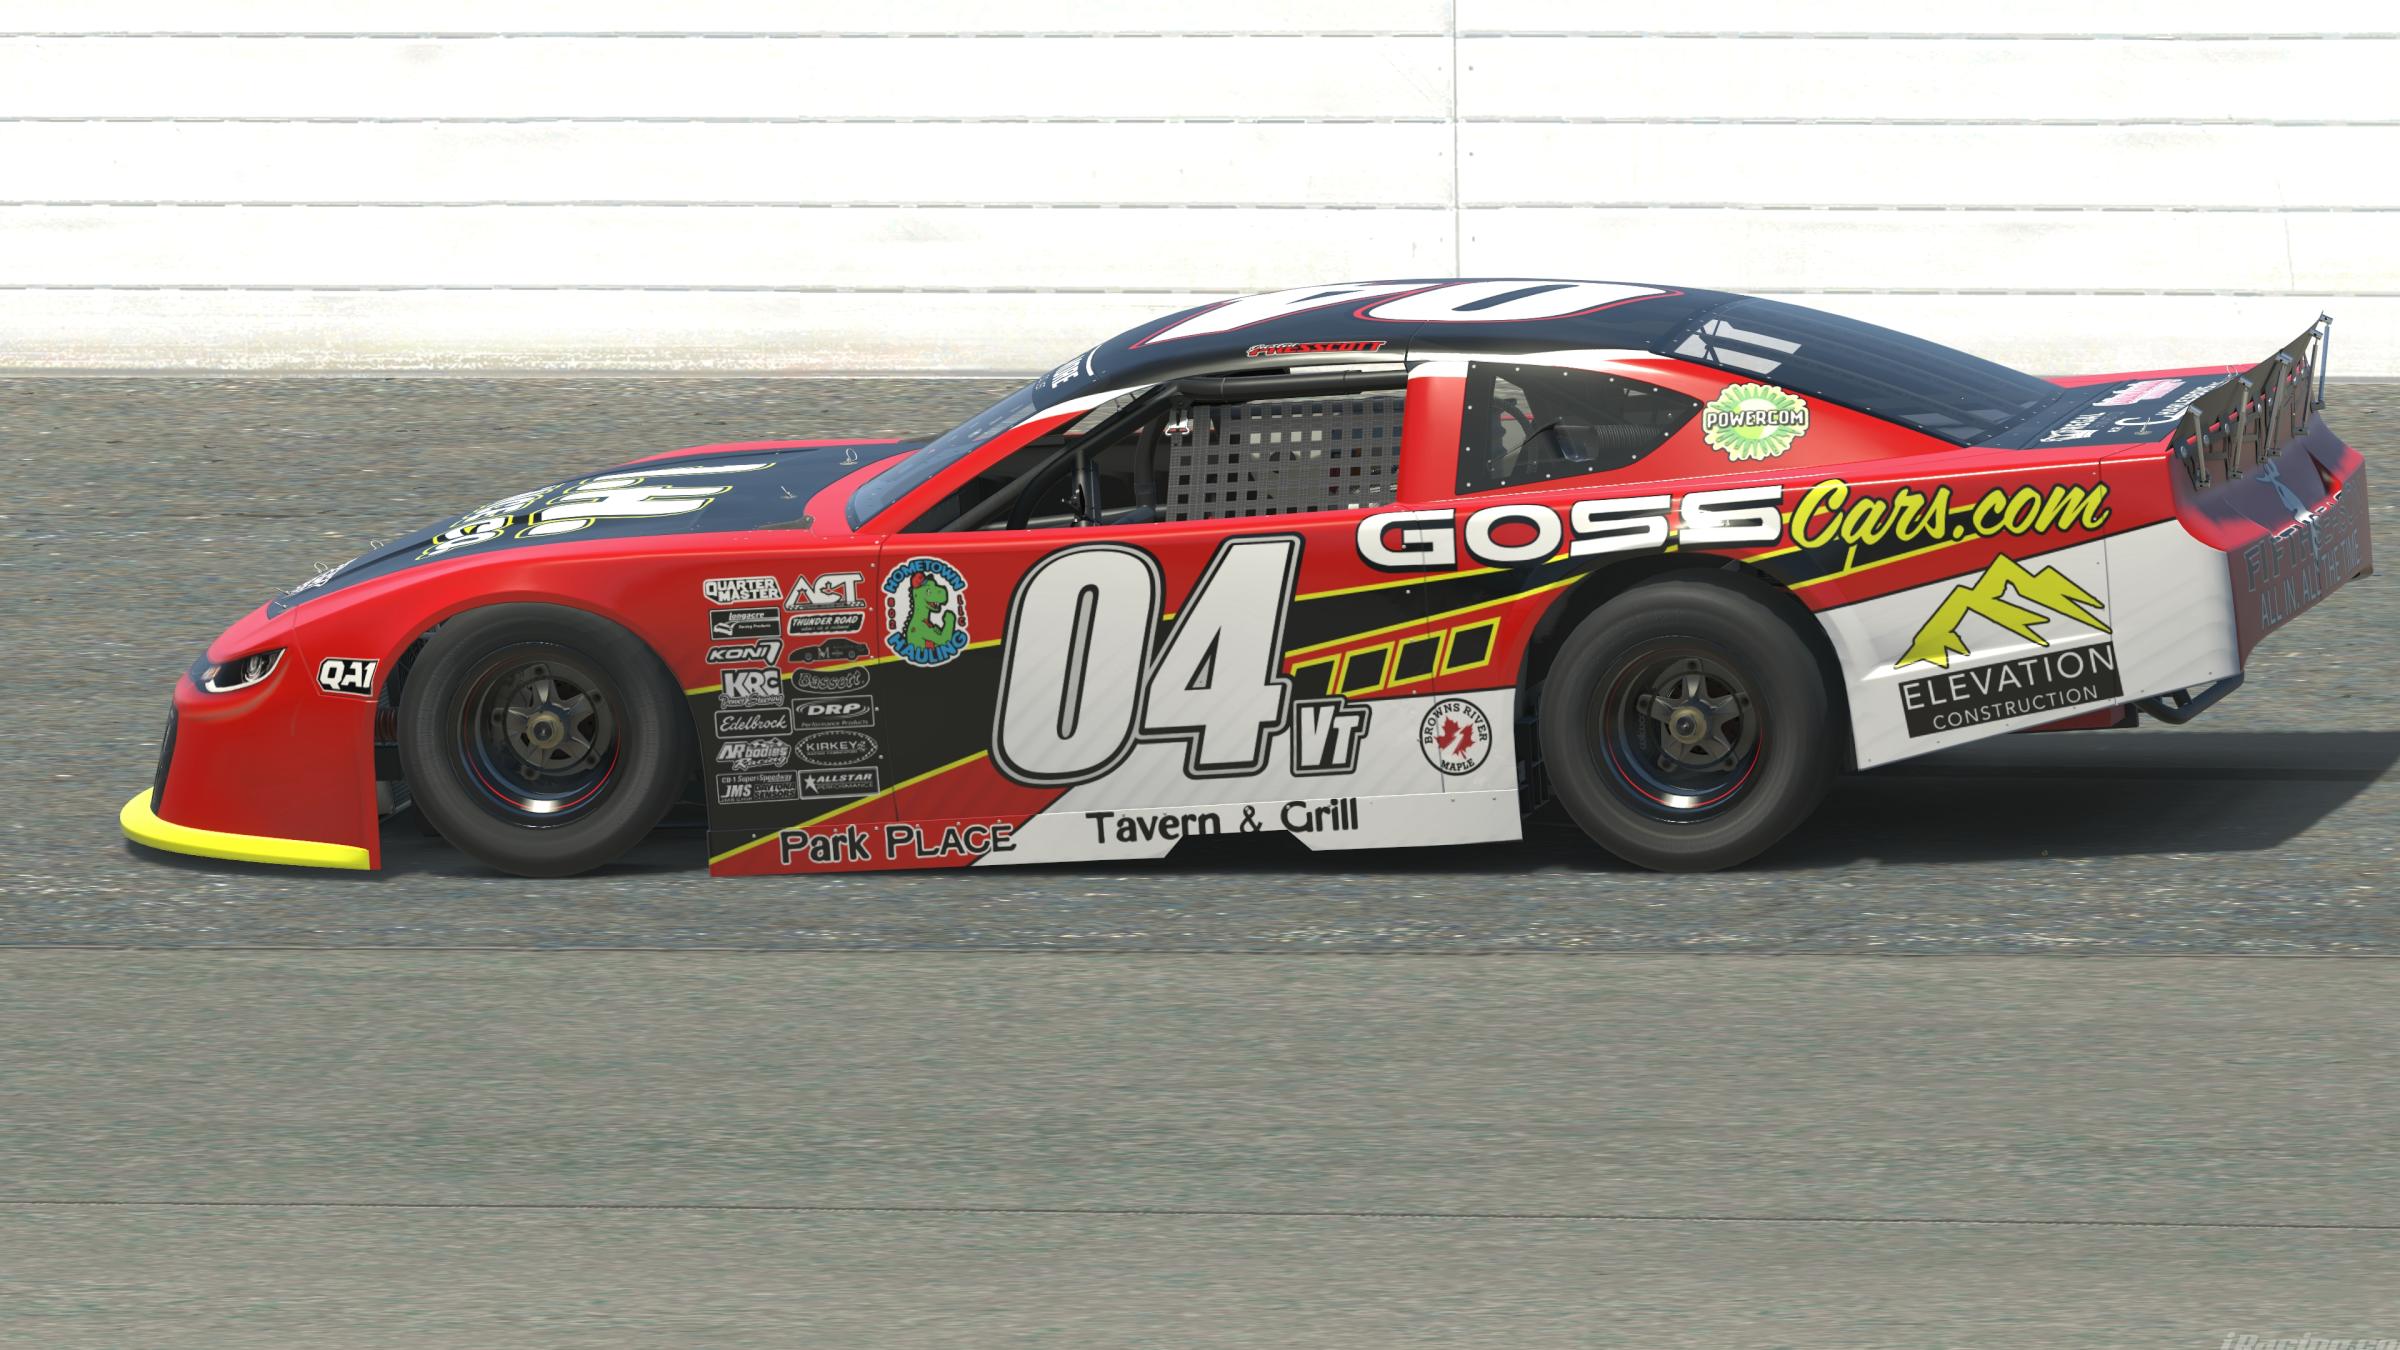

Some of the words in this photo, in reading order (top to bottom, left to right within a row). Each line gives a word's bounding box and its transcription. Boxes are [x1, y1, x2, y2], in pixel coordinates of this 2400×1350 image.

[1706, 410, 1805, 429] POWERCOM
[1356, 484, 1784, 573] GOSS
[1790, 478, 2112, 549] Cars.com
[705, 578, 774, 596] QUARTER
[883, 559, 966, 594] HOMETOWN
[718, 588, 779, 602] MASTER
[785, 573, 864, 609] ACT
[793, 616, 833, 627] THUNDER
[834, 615, 859, 625] ROAD
[887, 630, 968, 664] HAULING
[990, 534, 1303, 785] 04
[320, 660, 376, 690] QA1
[723, 670, 780, 697] KRC
[1902, 645, 2116, 711] ELEVATION
[807, 703, 861, 716] DRP
[1933, 685, 2098, 730] CONSTRUCTION
[720, 713, 788, 732] Edelbrock
[1294, 698, 1369, 774] VT
[1424, 703, 1460, 744] BROWNS
[1463, 706, 1488, 742] RIVER
[806, 740, 858, 751] KIRKEY
[816, 773, 873, 782] ALLSTAR
[1440, 758, 1475, 771] MAPLE
[720, 784, 752, 798] JMS
[779, 824, 871, 864] Park
[884, 823, 1017, 859] PLACE
[1085, 811, 1221, 844] Tavern
[1239, 805, 1263, 833] &
[1280, 797, 1359, 833] Grill
